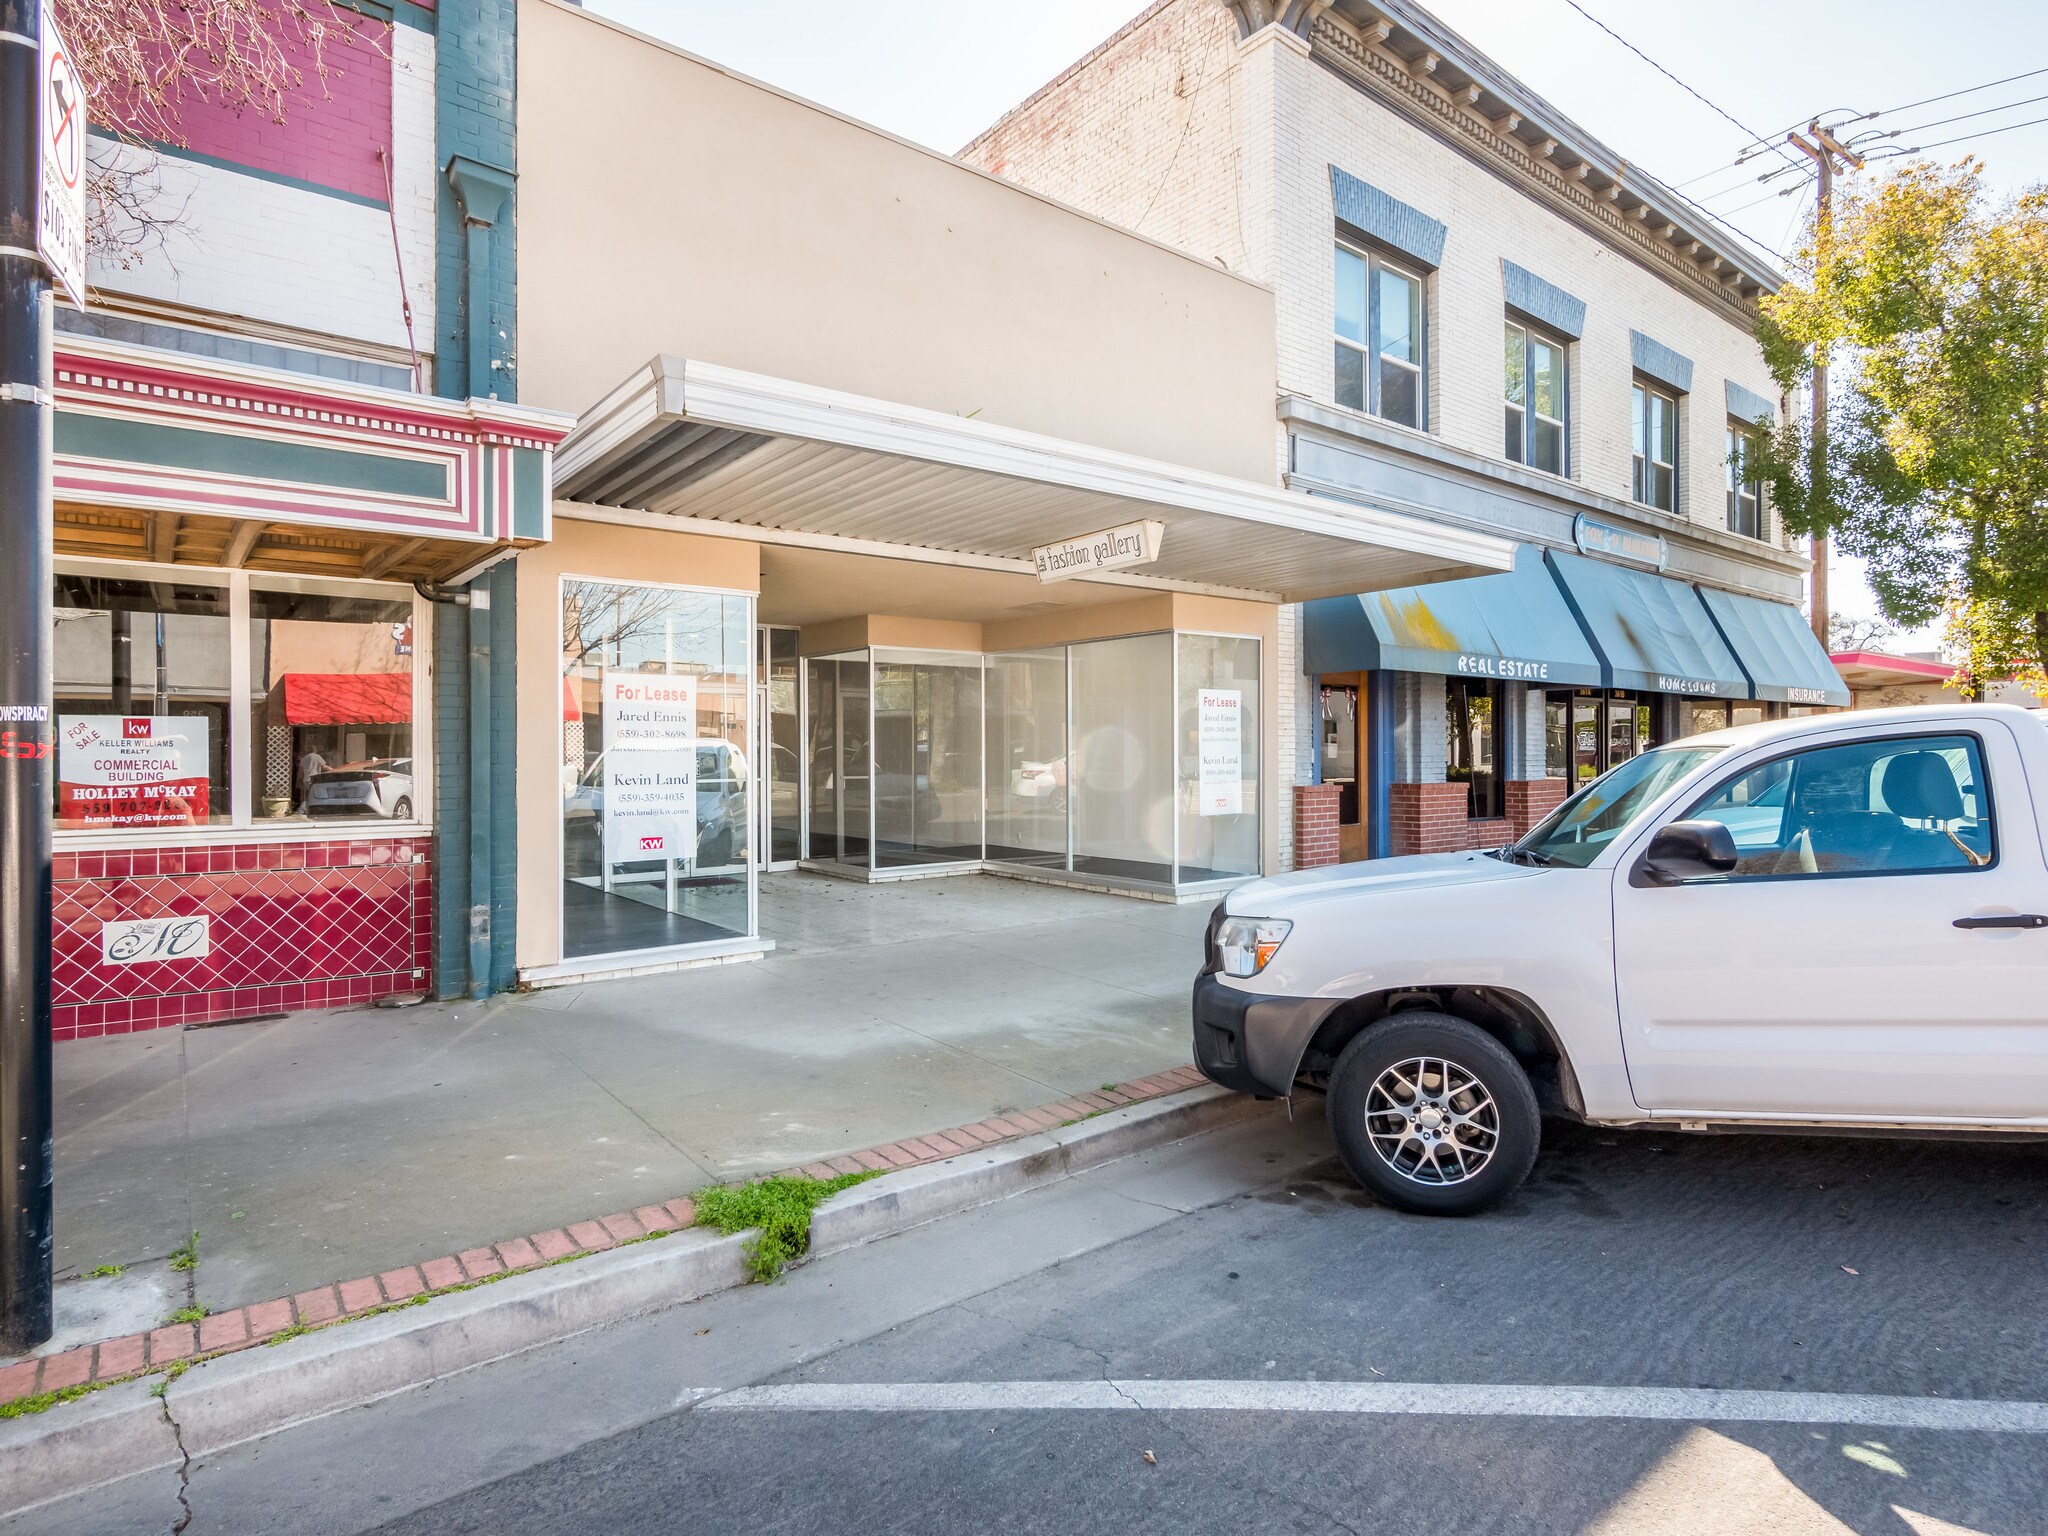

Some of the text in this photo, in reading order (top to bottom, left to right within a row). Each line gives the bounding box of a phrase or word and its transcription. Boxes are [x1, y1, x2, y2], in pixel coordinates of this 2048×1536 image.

[44, 190, 64, 248] $103
[67, 227, 82, 278] FINE
[1047, 545, 1091, 571] fashion
[1094, 532, 1141, 566] gallery
[1458, 655, 1548, 679] REAL ESTATE
[1659, 676, 1686, 692] HOME
[616, 684, 687, 701] For Lease
[1787, 688, 1825, 703] INSURANCE
[1203, 696, 1237, 707] For Lease
[617, 710, 687, 722] Jared Ennis
[67, 722, 88, 739] FOR
[128, 721, 149, 735] kw
[617, 729, 687, 739] (559)-302-8698
[75, 730, 101, 750] SALE
[94, 760, 178, 770] COMMERCIAL
[108, 772, 164, 781] BUILDING
[614, 773, 689, 786] Kevin Land
[72, 788, 139, 800] HOLLEY
[618, 792, 685, 802] (559)-359-4035
[82, 803, 110, 814] 559
[613, 808, 689, 818] kevin.land@kw.com
[641, 839, 663, 850] KW
